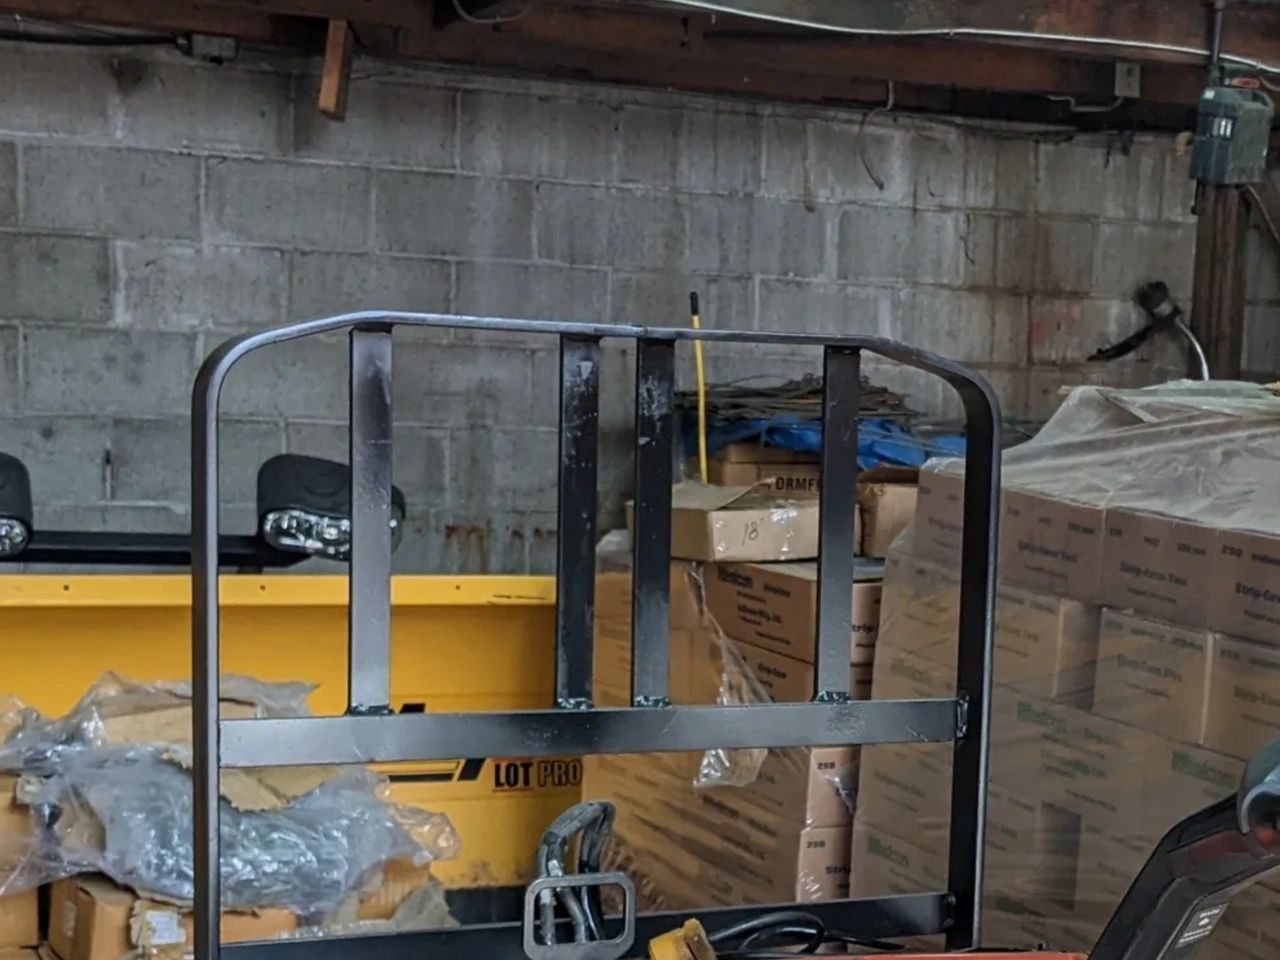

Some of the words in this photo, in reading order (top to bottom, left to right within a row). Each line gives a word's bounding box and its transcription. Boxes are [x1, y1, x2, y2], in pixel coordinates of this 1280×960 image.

[494, 762, 534, 788] LOT
[537, 760, 584, 788] PRO
[817, 762, 835, 770] 250
